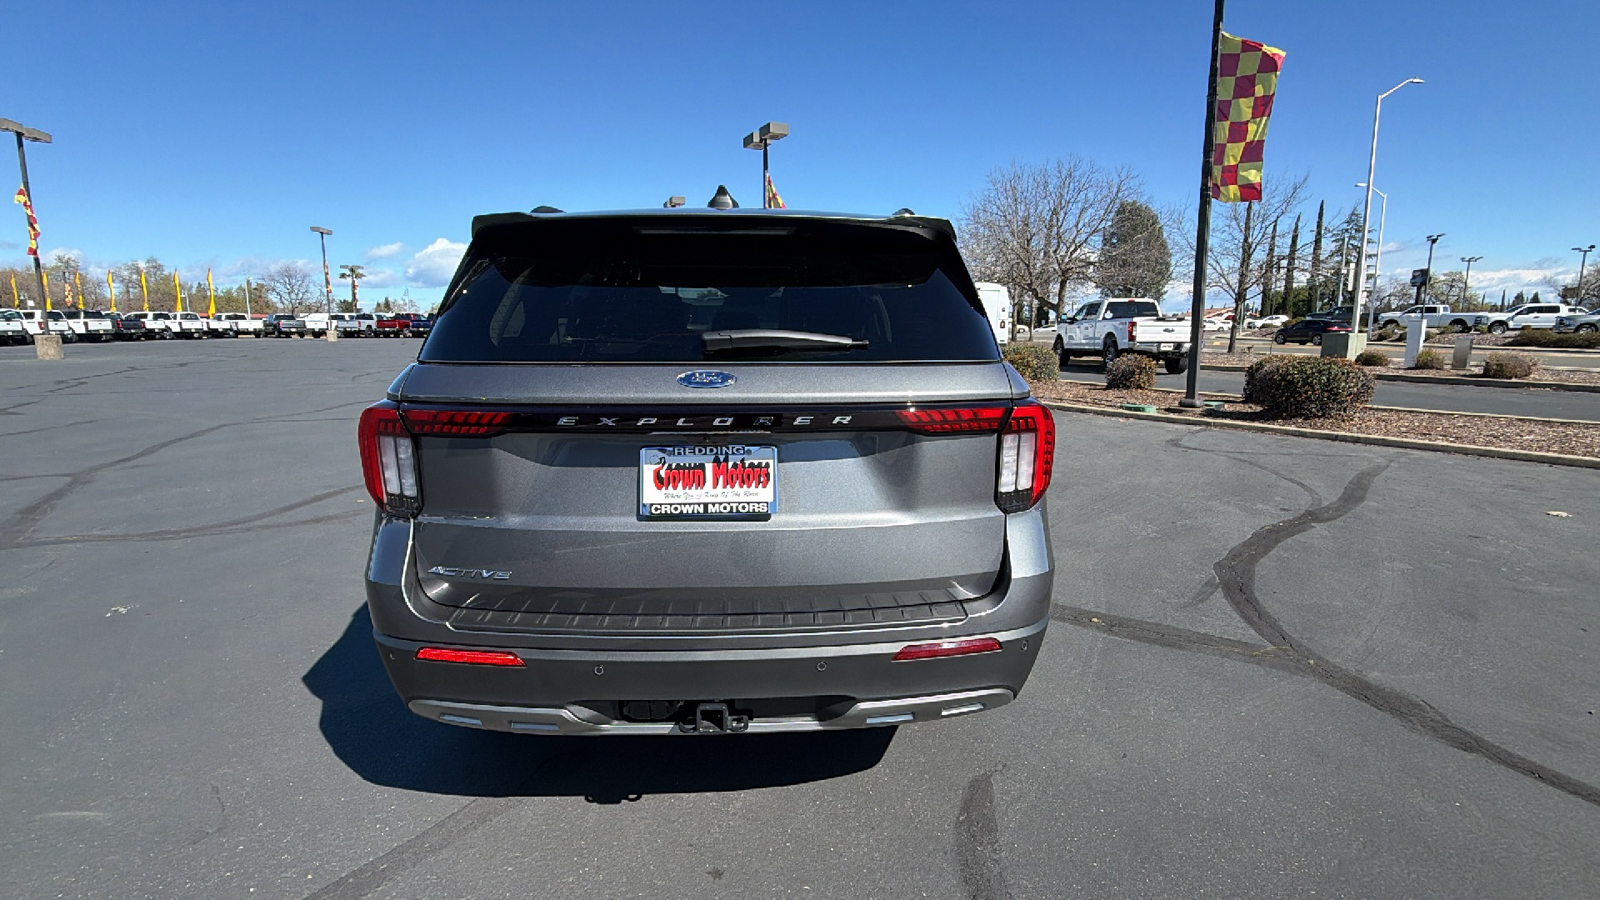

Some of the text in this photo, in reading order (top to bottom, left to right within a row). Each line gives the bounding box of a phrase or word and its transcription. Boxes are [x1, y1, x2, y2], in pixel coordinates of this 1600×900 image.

[556, 415, 853, 426] EXPLORER
[674, 446, 744, 456] REDDING
[652, 458, 770, 490] Crown Motors
[651, 502, 768, 514] CROWN MOTORS
[427, 566, 512, 579] ACTIVE
